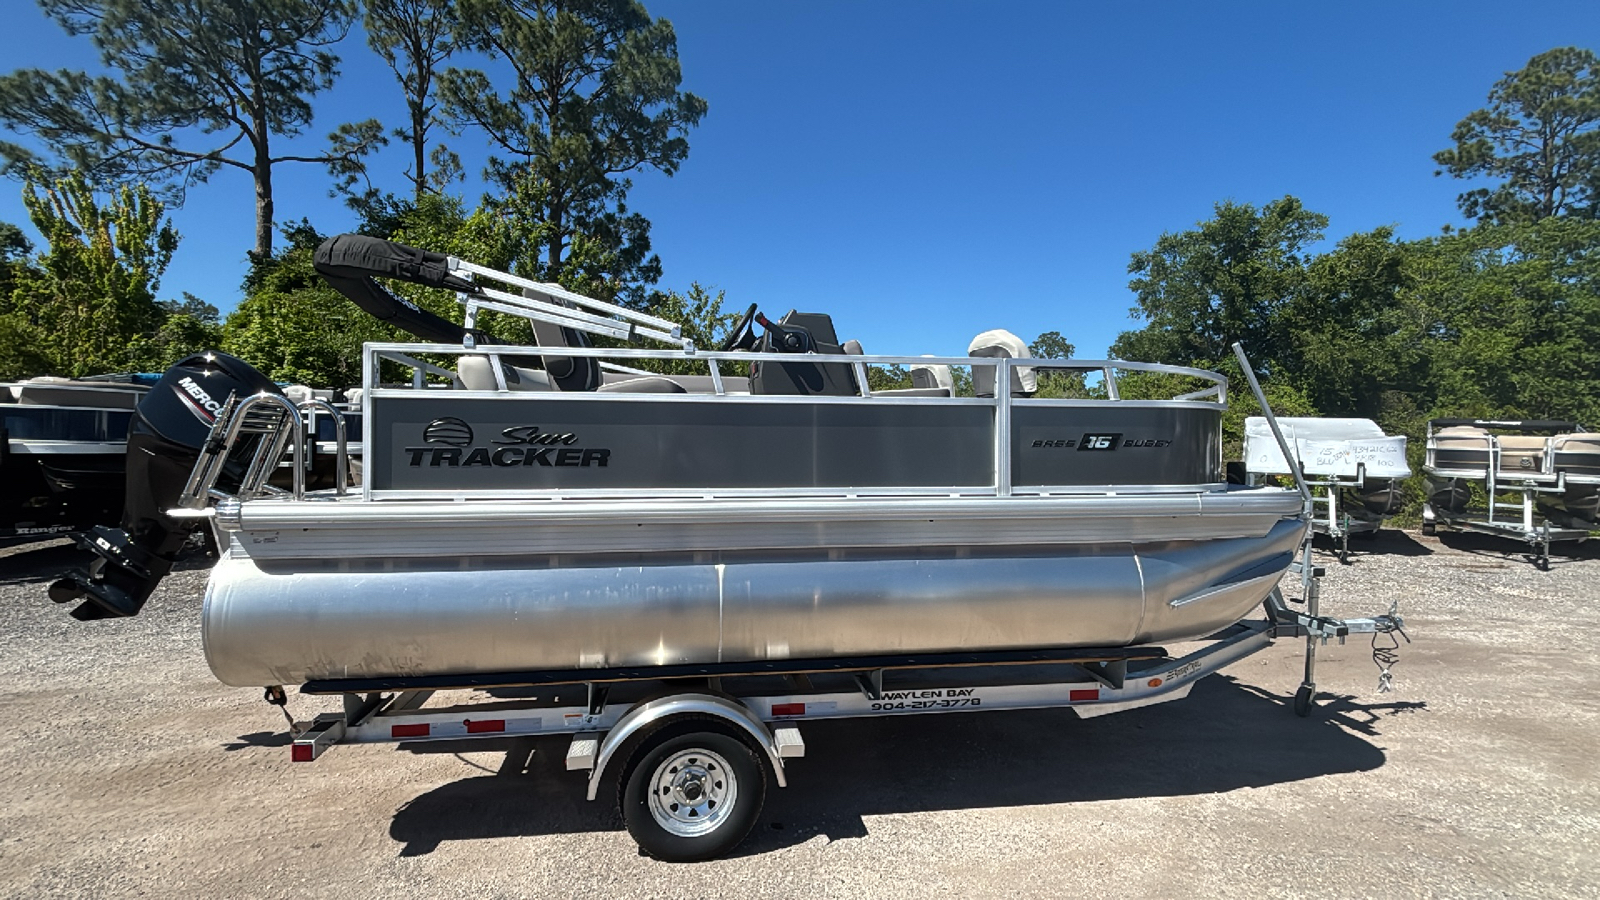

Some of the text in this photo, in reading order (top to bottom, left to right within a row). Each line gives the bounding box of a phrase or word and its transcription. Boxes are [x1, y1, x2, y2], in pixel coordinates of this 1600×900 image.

[178, 376, 225, 418] MERCU
[491, 426, 578, 446] Sun
[1031, 436, 1173, 449] BASS 16 BUGGY
[405, 447, 611, 468] TRACKER
[881, 689, 975, 701] WAYLEN BAY
[871, 698, 981, 711] 904-217-3778
